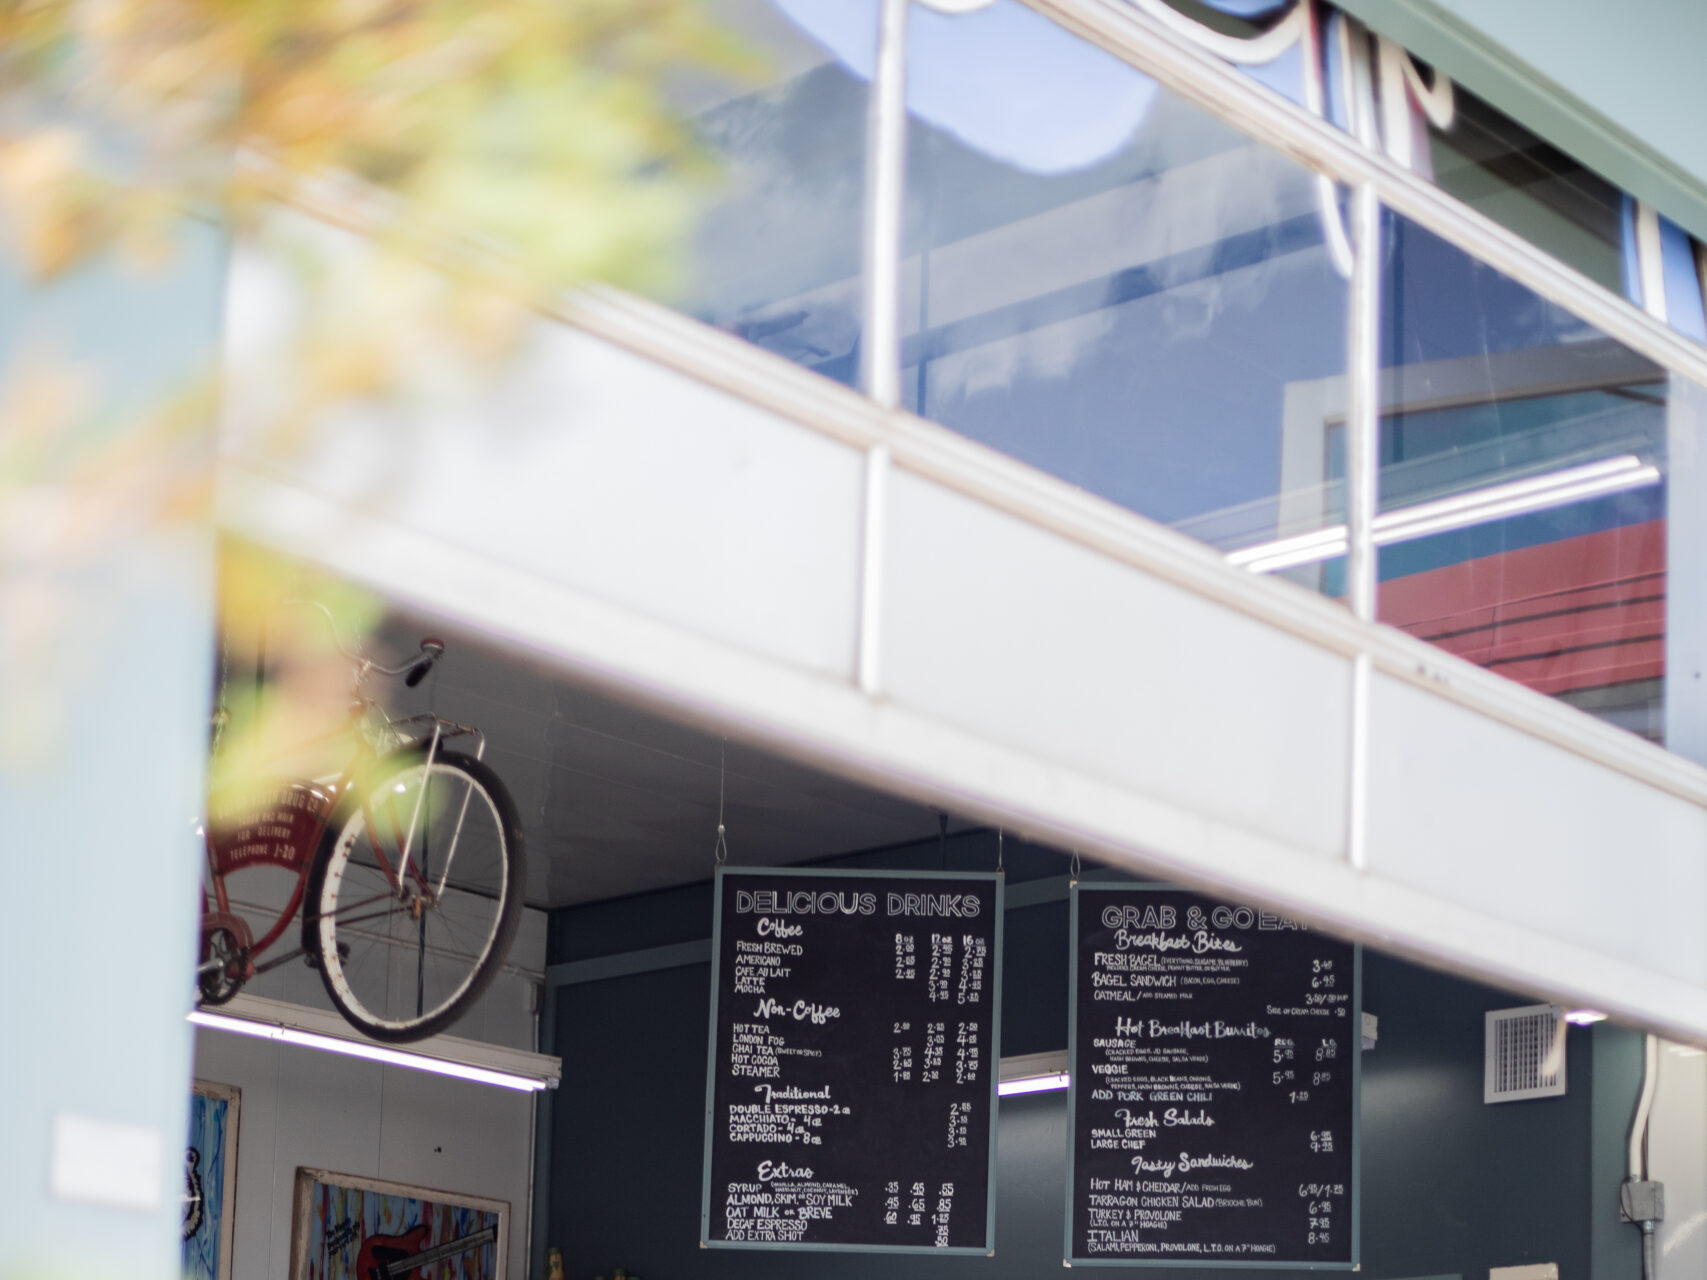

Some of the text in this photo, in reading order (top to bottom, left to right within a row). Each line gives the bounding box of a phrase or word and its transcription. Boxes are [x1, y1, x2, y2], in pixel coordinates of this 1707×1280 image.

[257, 825, 291, 839] DELIVERY
[230, 843, 269, 860] TELEPHONE
[736, 890, 981, 918] DELICIOUS DRINKS
[1101, 905, 1177, 929] GRAB
[1187, 905, 1207, 930] &
[1212, 905, 1254, 930] GO
[757, 917, 803, 938] Coffee
[1114, 929, 1243, 953] Breakfast Bites
[736, 941, 803, 956] FRESH BREWED
[735, 954, 781, 966] AMERICANO
[1094, 952, 1161, 967] FRESH BAGEL
[735, 966, 755, 976] CAFE
[770, 968, 791, 978] LAIT
[735, 976, 766, 986] LATTE
[1091, 971, 1127, 988] BAGEL
[1130, 973, 1177, 988] SANDWICH
[734, 985, 766, 994] MOCHA
[1093, 989, 1137, 1001] OATMEAL
[753, 998, 841, 1024] Non-Coffee
[733, 1023, 770, 1034] HOT TEA
[1115, 1016, 1145, 1038] Hot
[732, 1033, 785, 1046] LONDON FOG
[1093, 1039, 1136, 1049] SAUSAGE
[732, 1043, 774, 1056] CHAI TEA
[731, 1054, 779, 1065] HOT COCOA
[731, 1064, 780, 1078] STEAMER
[1091, 1064, 1129, 1075] VEGGIE
[754, 1083, 832, 1104] Traditional
[1091, 1089, 1213, 1102] ADD PORK GREEN CHILI
[729, 1104, 771, 1114] DOUBLE
[1114, 1107, 1216, 1128] Fresh Salads
[1091, 1128, 1157, 1139] SMALL GREEN
[1090, 1139, 1146, 1150] LARGE CHEF
[757, 1160, 814, 1182] Extras
[1131, 1152, 1254, 1178] Tasty Sandwiches
[727, 1182, 762, 1193] SYRUP
[1090, 1177, 1111, 1191] HOT
[1114, 1178, 1134, 1192] HAM
[805, 1194, 827, 1206] SOY
[827, 1194, 853, 1207] MILK
[1088, 1194, 1138, 1207] TARRAGON
[1141, 1196, 1179, 1208] CHICKEN
[1182, 1195, 1215, 1209] SALAD
[726, 1206, 749, 1218] OAT
[753, 1206, 780, 1218] MILK
[798, 1206, 833, 1220] BREVE
[1088, 1207, 1183, 1222] TURKEY PROVOLONE
[727, 1218, 755, 1230] DECAF
[757, 1219, 808, 1232] ESPRESSO
[725, 1230, 745, 1241] ADD
[747, 1230, 776, 1241] EXTRA
[777, 1230, 804, 1241] SHOT
[1087, 1229, 1139, 1243] ITALIAN
